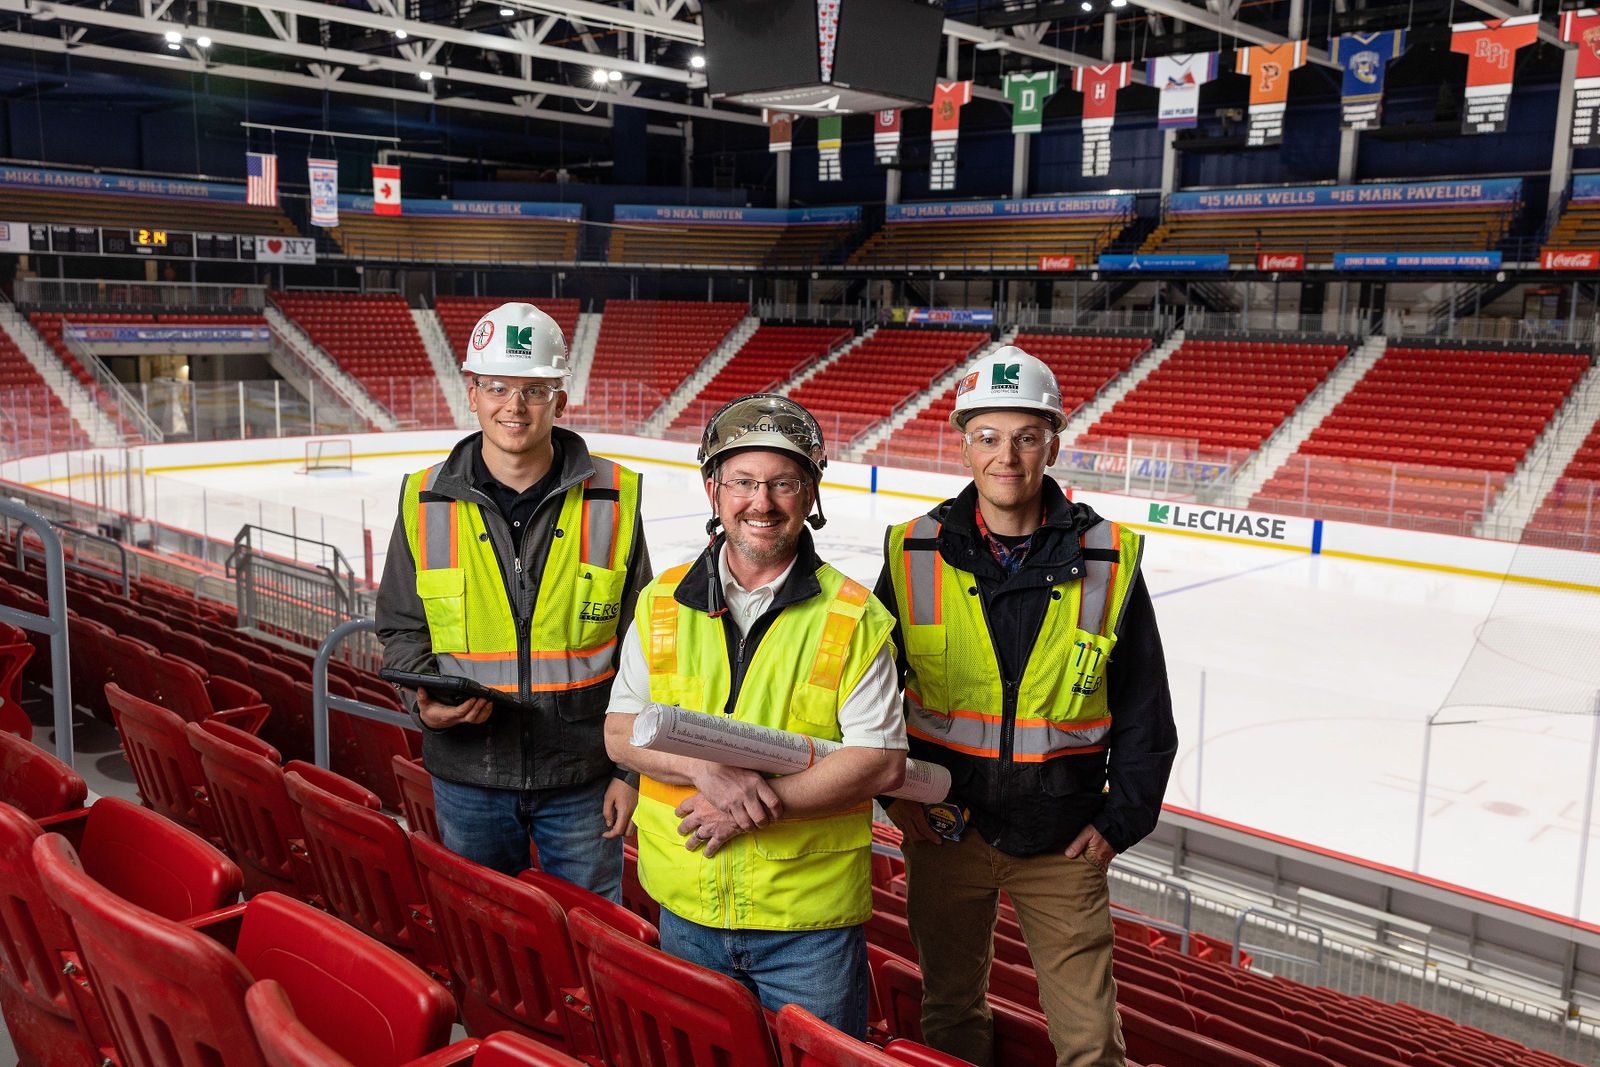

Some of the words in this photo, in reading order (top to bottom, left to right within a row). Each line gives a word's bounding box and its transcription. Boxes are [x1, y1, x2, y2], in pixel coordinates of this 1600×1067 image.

[1475, 37, 1509, 69] RPI
[1259, 61, 1281, 93] P
[1094, 83, 1106, 99] H
[1021, 89, 1037, 111] D
[5, 170, 41, 184] MIKE
[44, 174, 103, 188] RAMSEY
[138, 180, 163, 194] BILL
[168, 182, 209, 197] BAKER
[1200, 195, 1220, 206] #15
[1223, 193, 1263, 206] MARK
[1266, 191, 1316, 204] WELLS
[1331, 189, 1355, 202] #16
[1358, 187, 1403, 201] MARK
[1406, 184, 1482, 200] PAVELICH
[468, 203, 495, 214] DAVE
[497, 204, 522, 214] SILK
[673, 208, 700, 219] NEAL
[702, 209, 743, 220] BROTEN
[901, 206, 917, 216] #10
[918, 205, 946, 216] MARK
[948, 203, 994, 215] JOHNSON
[1004, 202, 1020, 213] #11
[1022, 200, 1056, 213] STEVE
[1058, 198, 1119, 211] CHRISTOFF
[259, 238, 266, 253] I
[284, 239, 313, 255] NY
[1457, 257, 1489, 265] ARENA
[580, 601, 619, 616] ZERO
